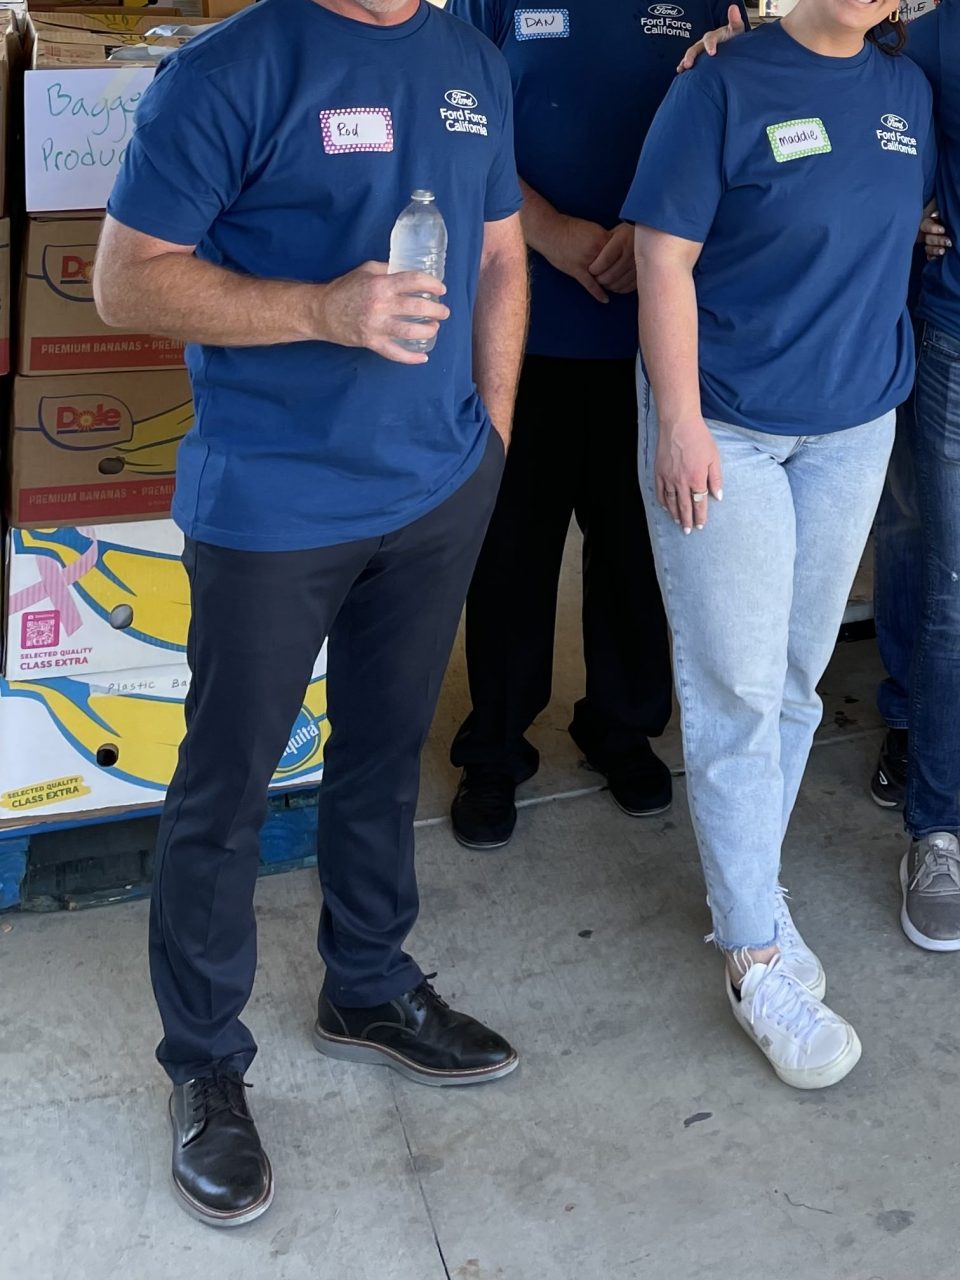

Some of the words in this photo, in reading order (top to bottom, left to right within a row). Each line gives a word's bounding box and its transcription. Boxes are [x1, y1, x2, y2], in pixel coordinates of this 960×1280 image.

[654, 5, 678, 16] Ford
[525, 15, 555, 28] DAN
[641, 18, 664, 26] Ford
[666, 18, 692, 30] Force
[644, 25, 690, 38] California
[451, 91, 474, 107] Ford
[47, 83, 141, 143] Bagge
[440, 108, 464, 120] Ford
[465, 110, 487, 125] Force
[337, 122, 359, 137] Rod
[445, 120, 488, 136] California
[887, 115, 903, 129] Ford
[876, 129, 897, 141] Ford
[897, 132, 916, 146] Force
[881, 139, 917, 156] California
[41, 343, 91, 354] PREMIUM
[93, 341, 141, 352] BANANAS
[152, 338, 185, 350] PREMI
[57, 403, 121, 429] Dole
[29, 492, 77, 505] PREMIUM
[80, 488, 127, 502] BANANAS
[142, 484, 174, 496] PREMI
[20, 651, 58, 660] SELECTED
[59, 647, 92, 657] QUALITY
[20, 660, 52, 670] CLASS
[55, 656, 88, 667] EXTRA
[108, 682, 156, 695] Plastic
[171, 678, 188, 689] Ba
[283, 724, 319, 756] quita
[8, 786, 45, 800] SELECTED
[46, 777, 79, 790] QUALITY
[11, 793, 44, 808] CLASS
[46, 785, 80, 800] EXTRA
